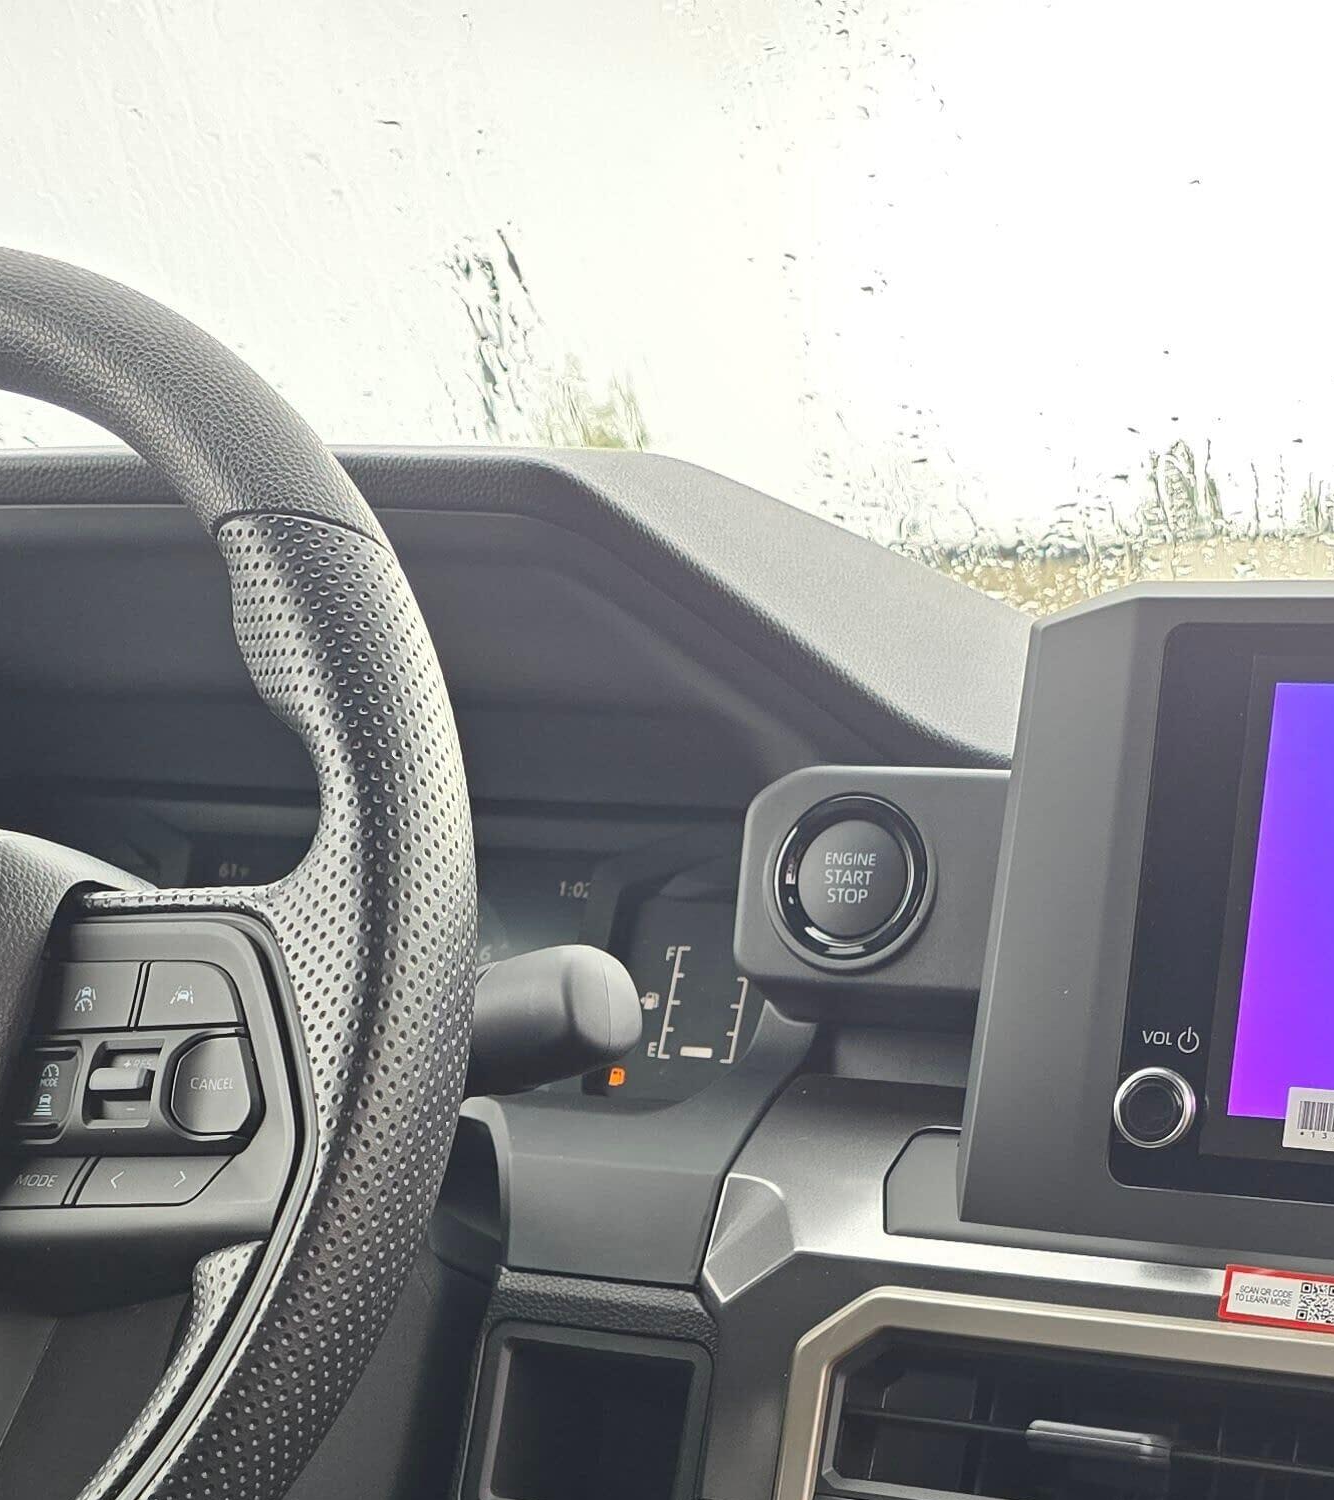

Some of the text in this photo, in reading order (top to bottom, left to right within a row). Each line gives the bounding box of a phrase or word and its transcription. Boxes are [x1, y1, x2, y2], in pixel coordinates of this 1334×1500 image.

[825, 853, 876, 866] ENGINE
[824, 869, 873, 885] START
[827, 888, 868, 904] STOP
[1142, 1029, 1173, 1047] VOL
[190, 1077, 234, 1090] CANCEL
[15, 1173, 58, 1188] MODE
[1234, 1293, 1291, 1307] TO LEARN MORE
